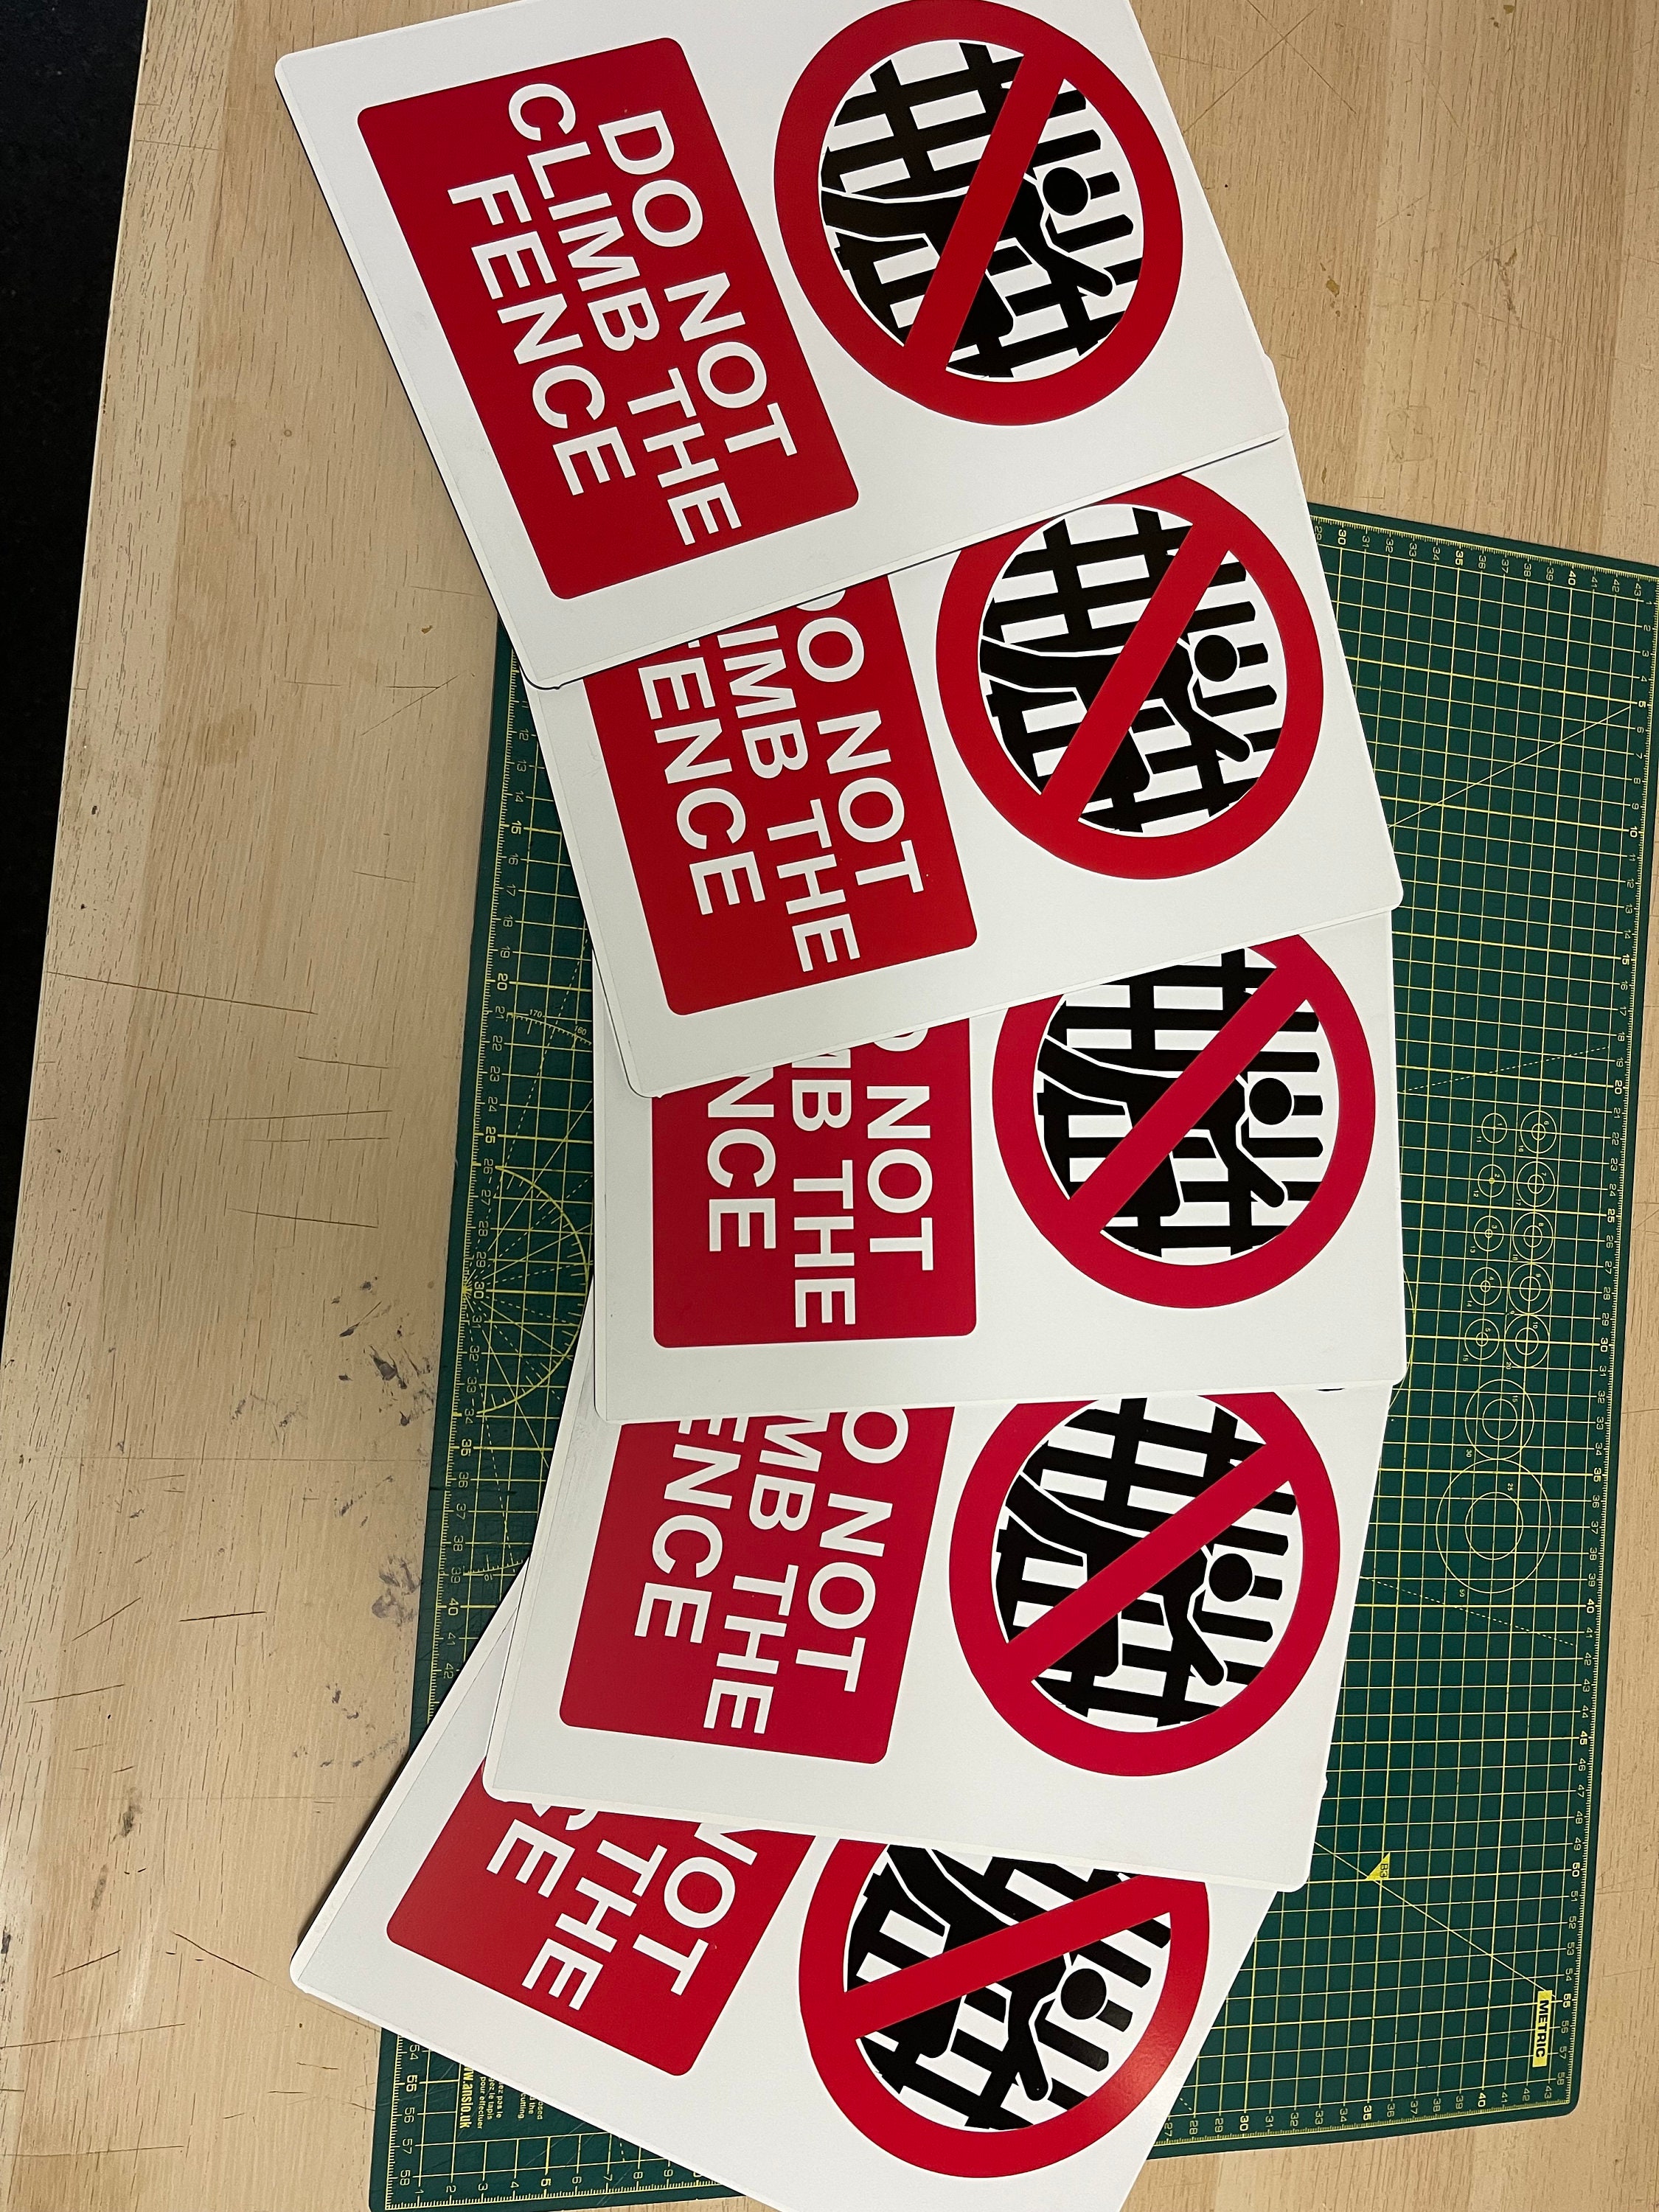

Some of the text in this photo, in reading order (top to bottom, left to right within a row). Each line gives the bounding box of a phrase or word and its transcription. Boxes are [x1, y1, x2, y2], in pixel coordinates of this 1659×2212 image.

[599, 110, 797, 456] DO NOT
[509, 83, 742, 545] CLIMB THE
[447, 173, 636, 495] FENCE
[1338, 529, 1346, 546] 30
[1362, 536, 1370, 548] 31
[1385, 538, 1394, 553] 32
[1409, 543, 1417, 557] 33
[1433, 548, 1440, 561] 34
[1455, 551, 1463, 566] 35
[1478, 555, 1486, 569] 36
[1502, 559, 1509, 574] 37
[1524, 563, 1531, 577] 38
[1546, 567, 1554, 581] 39
[1568, 570, 1576, 585] 40
[1591, 577, 1598, 588] 41
[1613, 579, 1619, 593] 42
[1634, 583, 1641, 597] 43
[796, 590, 925, 893] O NOT
[639, 640, 765, 916] ENCE
[717, 625, 808, 779] IMB
[767, 799, 860, 972] THE
[1630, 826, 1638, 838] 10
[1629, 854, 1635, 862] 11
[1622, 954, 1630, 965] 15
[1614, 1079, 1622, 1094] 20
[1613, 1108, 1621, 1119] 21
[1612, 1132, 1619, 1145] 22
[707, 1067, 776, 1252] NCE
[1610, 1158, 1618, 1171] 23
[866, 1086, 933, 1271] NOT
[1609, 1184, 1616, 1197] 24
[1607, 1208, 1615, 1223] 25
[792, 1160, 855, 1328] THE
[1606, 1235, 1613, 1248] 26
[1604, 1261, 1612, 1274] 27
[1603, 1287, 1610, 1300] 28
[1601, 1312, 1610, 1326] 29
[1600, 1338, 1608, 1352] 30
[1599, 1366, 1607, 1377] 31
[1598, 1391, 1605, 1403] 32
[1596, 1416, 1604, 1430] 33
[1595, 1443, 1603, 1455] 34
[1593, 1467, 1601, 1482] 35
[1592, 1495, 1599, 1508] 36
[635, 1416, 749, 1644] NCE
[1591, 1521, 1599, 1534] 37
[796, 1409, 908, 1692] O NOT
[1590, 1548, 1597, 1561] 38
[1588, 1573, 1596, 1587] 39
[1586, 1599, 1594, 1613] 40
[1585, 1627, 1593, 1638] 41
[703, 1565, 799, 1733] THE
[1584, 1652, 1591, 1666] 42
[1582, 1679, 1590, 1692] 43
[1582, 1705, 1589, 1718] 44
[1579, 1731, 1588, 1745] 45
[1572, 1863, 1580, 1877] 50
[1571, 1891, 1578, 1902] 51
[521, 1840, 667, 2011] THE
[1568, 1916, 1576, 1929] 52
[1567, 1942, 1575, 1955] 53
[1565, 1969, 1573, 1982] 54
[1562, 1993, 1571, 2008] 55
[1536, 2000, 1548, 2057] METRIC
[1559, 2046, 1568, 2059] 57
[1557, 2072, 1565, 2085] 58
[400, 2045, 420, 2185] 54 55 56 57 58
[446, 2185, 456, 2193] 2
[541, 2179, 552, 2187] 5
[572, 2176, 582, 2184] 6
[603, 2174, 613, 2182] 7
[633, 2171, 643, 2180] 8
[664, 2168, 673, 2177] 9
